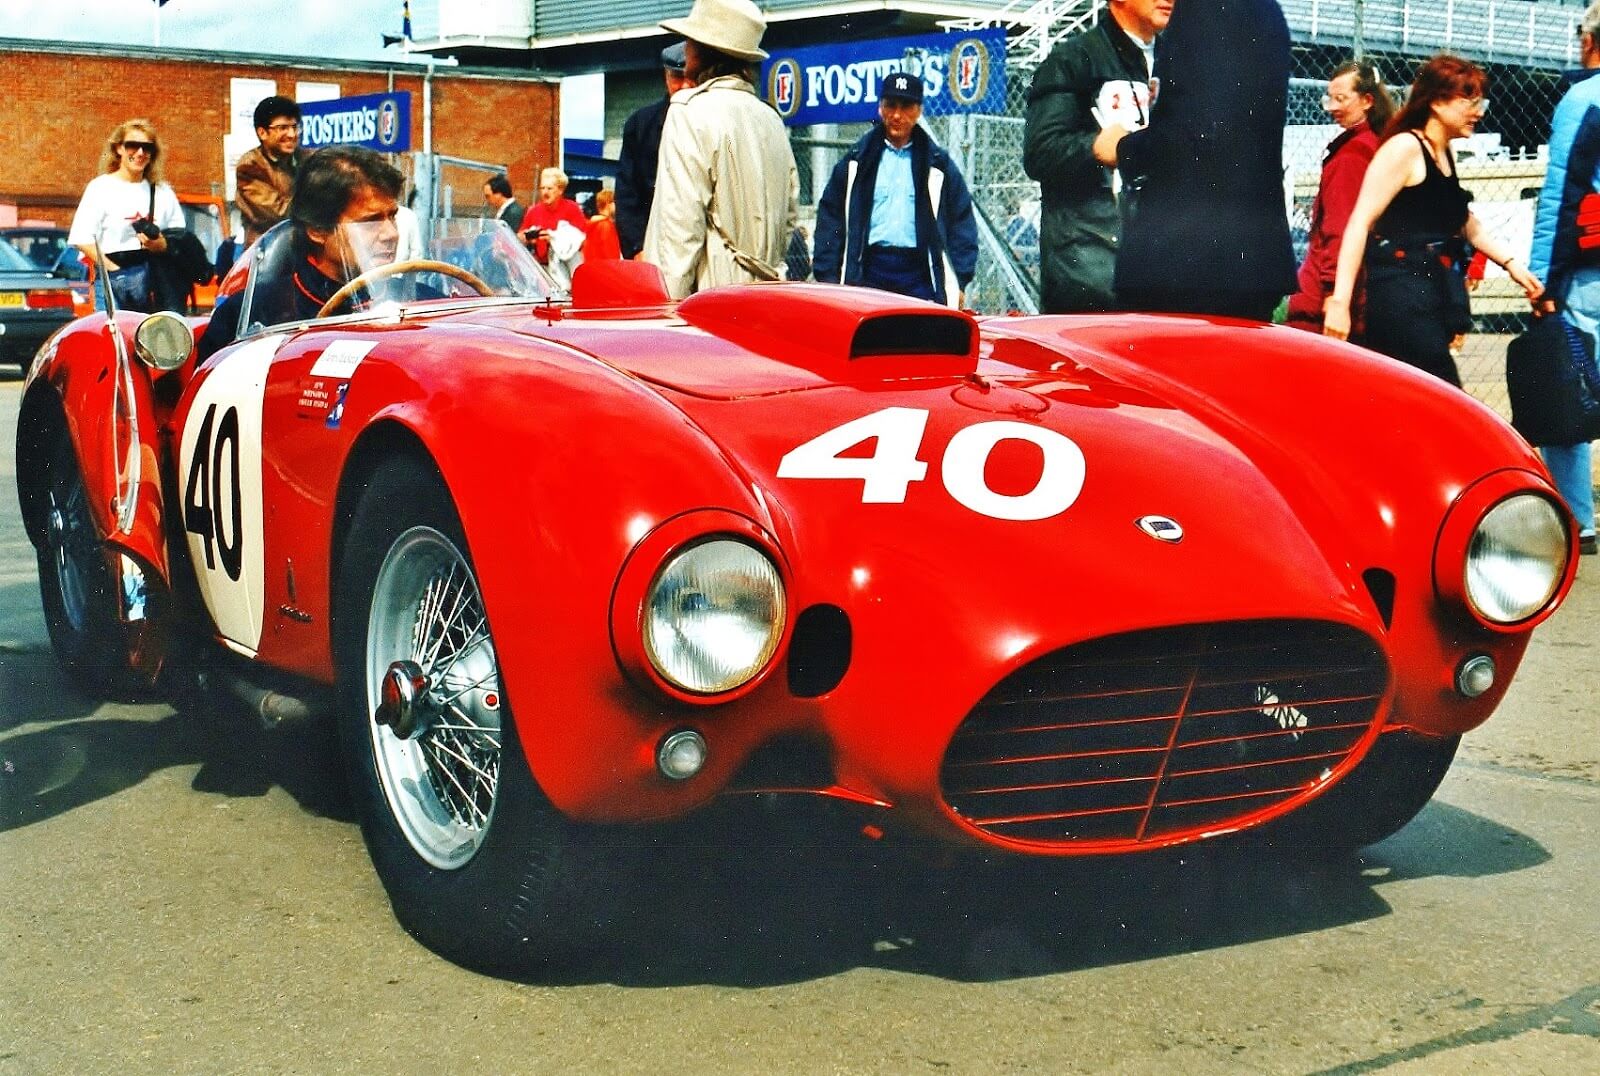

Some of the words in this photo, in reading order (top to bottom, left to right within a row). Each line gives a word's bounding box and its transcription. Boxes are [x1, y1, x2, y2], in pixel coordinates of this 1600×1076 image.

[302, 105, 377, 146] FOSTER'S
[185, 403, 242, 582] 40
[776, 406, 1086, 521] 40
